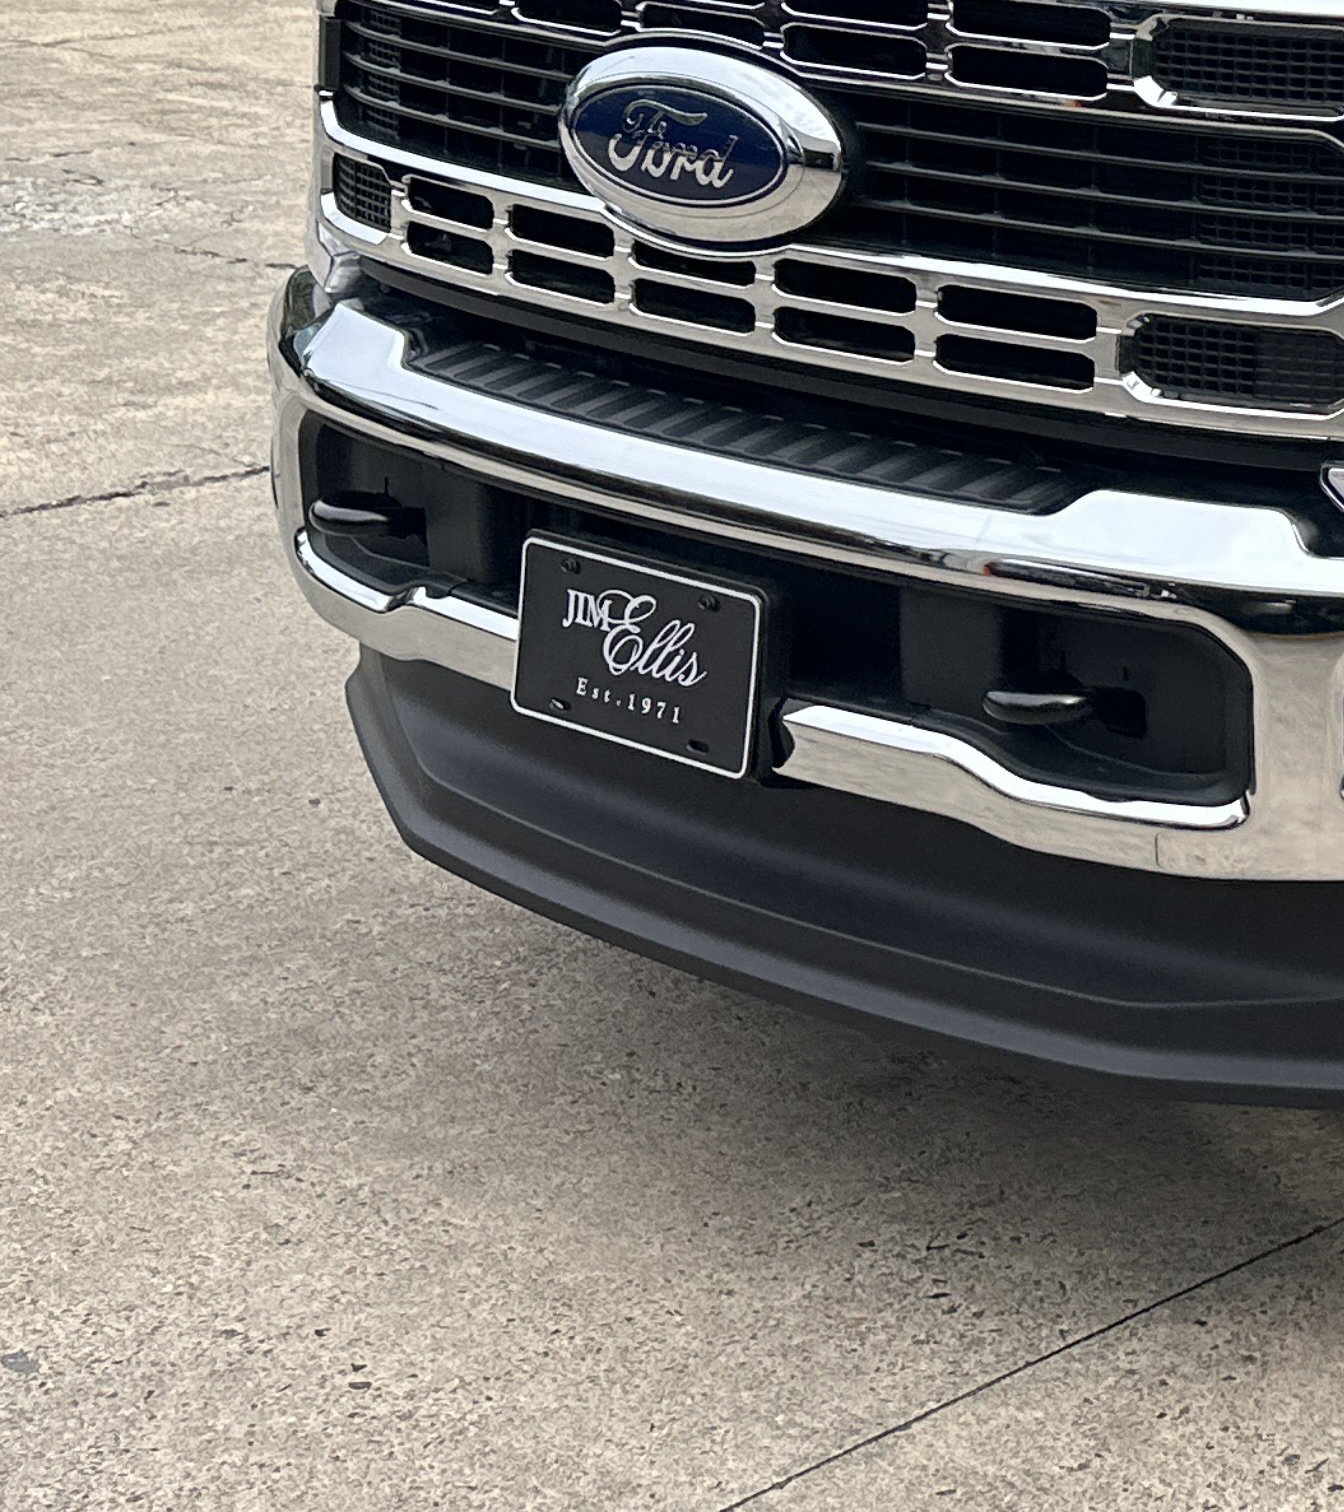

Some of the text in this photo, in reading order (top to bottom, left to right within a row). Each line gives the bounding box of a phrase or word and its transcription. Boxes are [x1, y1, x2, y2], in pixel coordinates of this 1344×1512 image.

[607, 98, 739, 189] Ford
[562, 589, 708, 688] JIM Ellis
